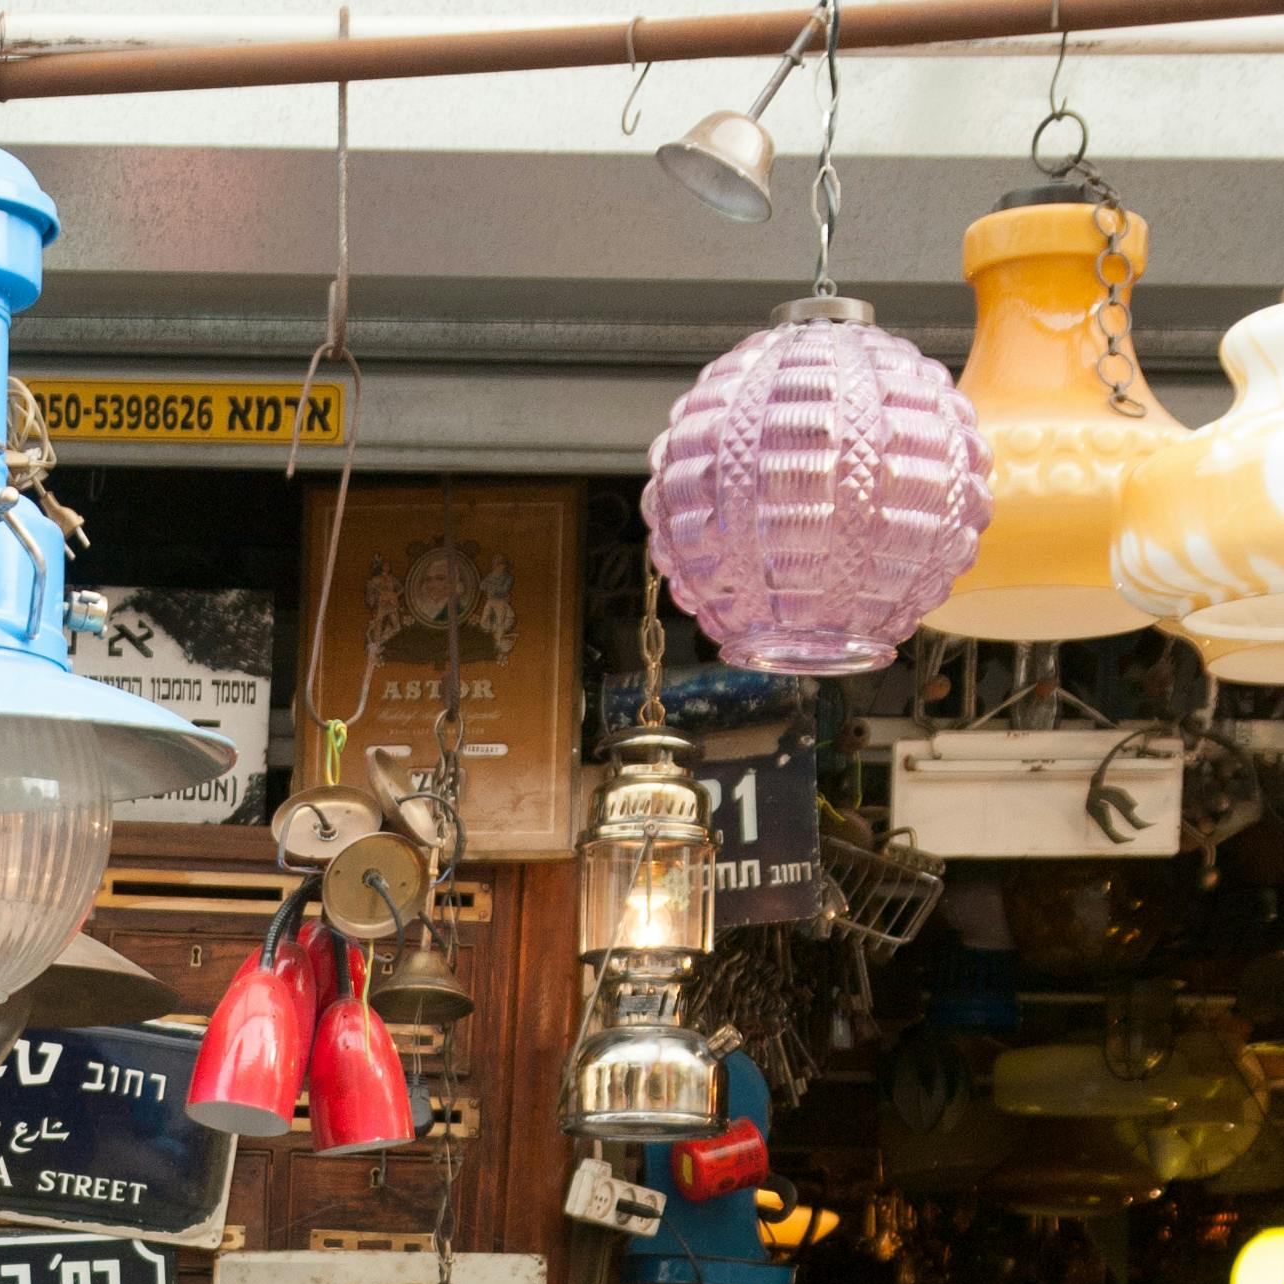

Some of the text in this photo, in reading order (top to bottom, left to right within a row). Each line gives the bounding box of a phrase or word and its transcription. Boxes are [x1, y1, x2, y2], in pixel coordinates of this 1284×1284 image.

[211, 678, 257, 706] מוסמך
[770, 862, 812, 885] רחוב
[82, 1060, 167, 1100] רחוב
[11, 1115, 70, 1152] شارع
[37, 1169, 148, 1205] STREET
